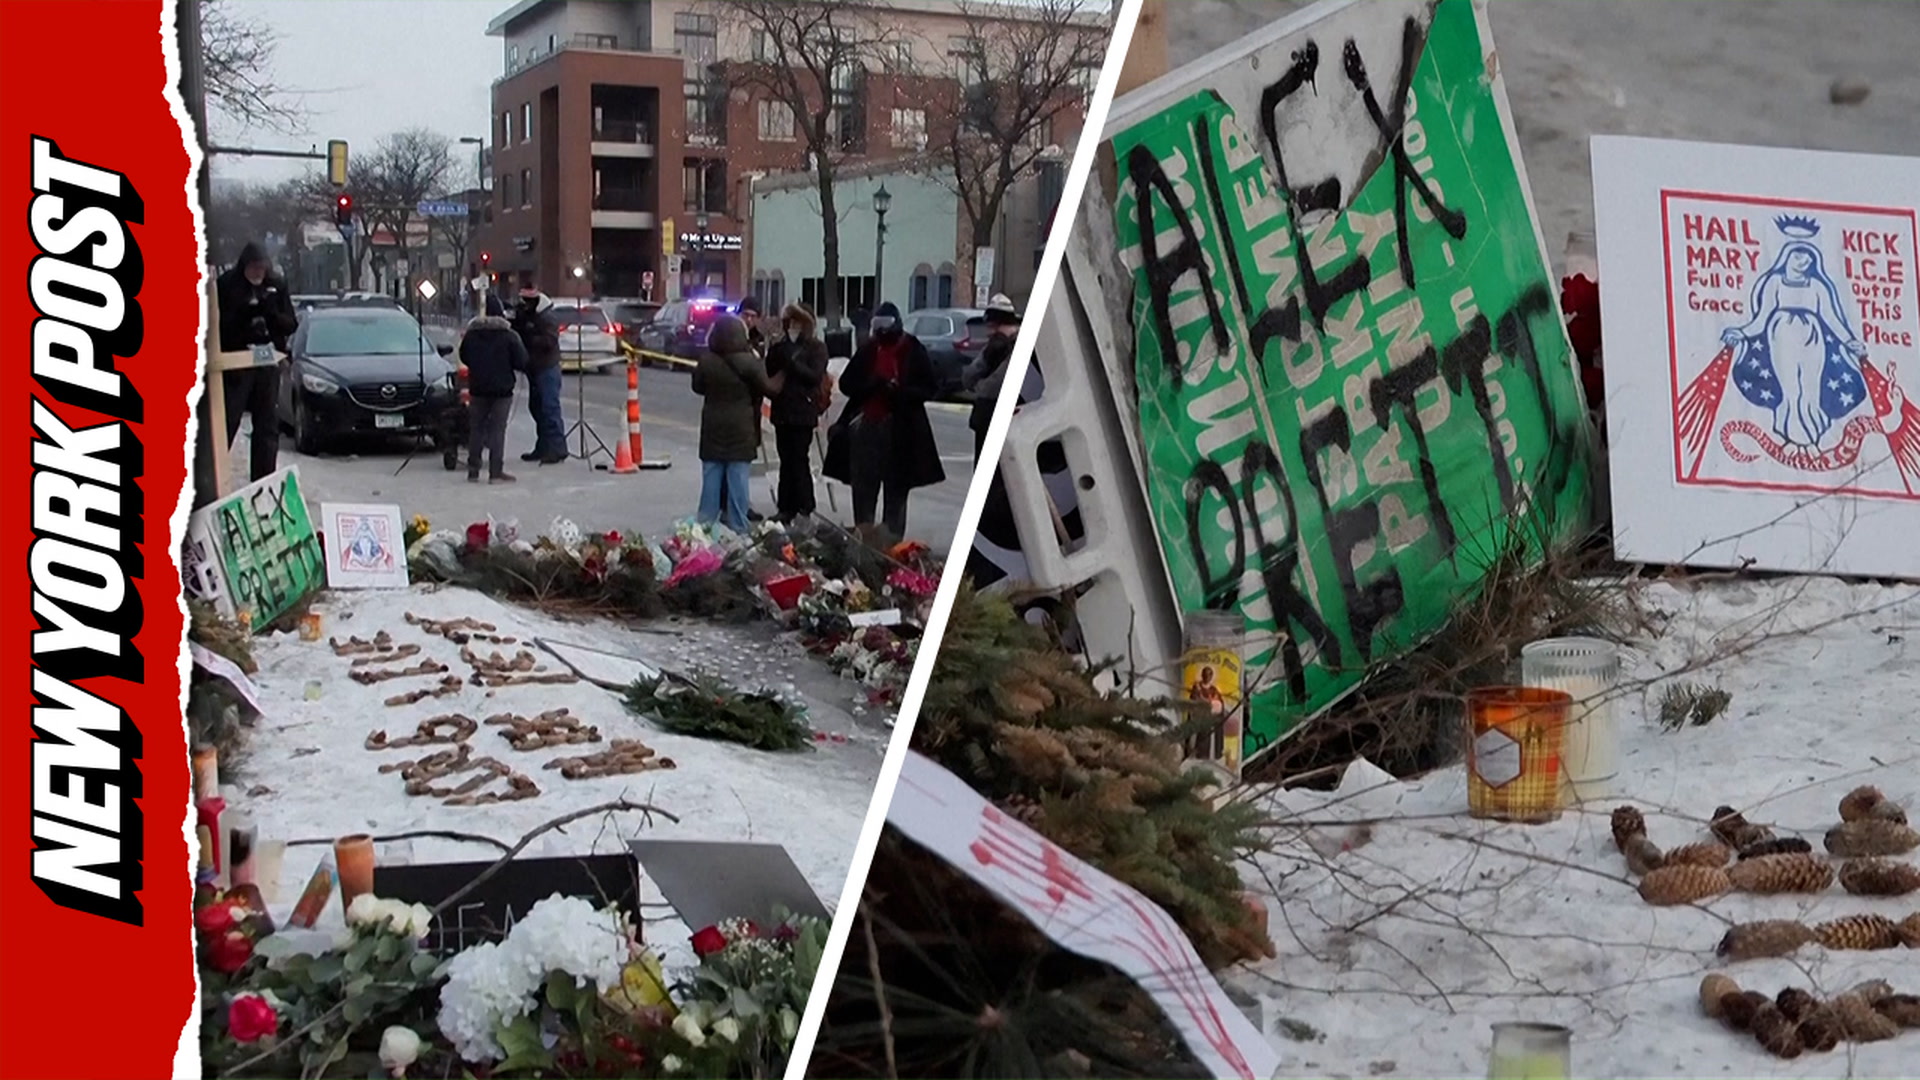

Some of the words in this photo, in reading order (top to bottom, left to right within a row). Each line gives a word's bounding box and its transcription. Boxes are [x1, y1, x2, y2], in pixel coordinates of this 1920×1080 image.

[1128, 15, 1467, 390] ALEX
[1683, 213, 1760, 246] HAIL
[1842, 228, 1899, 256] KICK
[1686, 245, 1760, 271] MARY
[1687, 270, 1721, 288] Full
[1856, 299, 1903, 321] This
[1862, 322, 1913, 347] Place
[223, 481, 296, 554] ALEX
